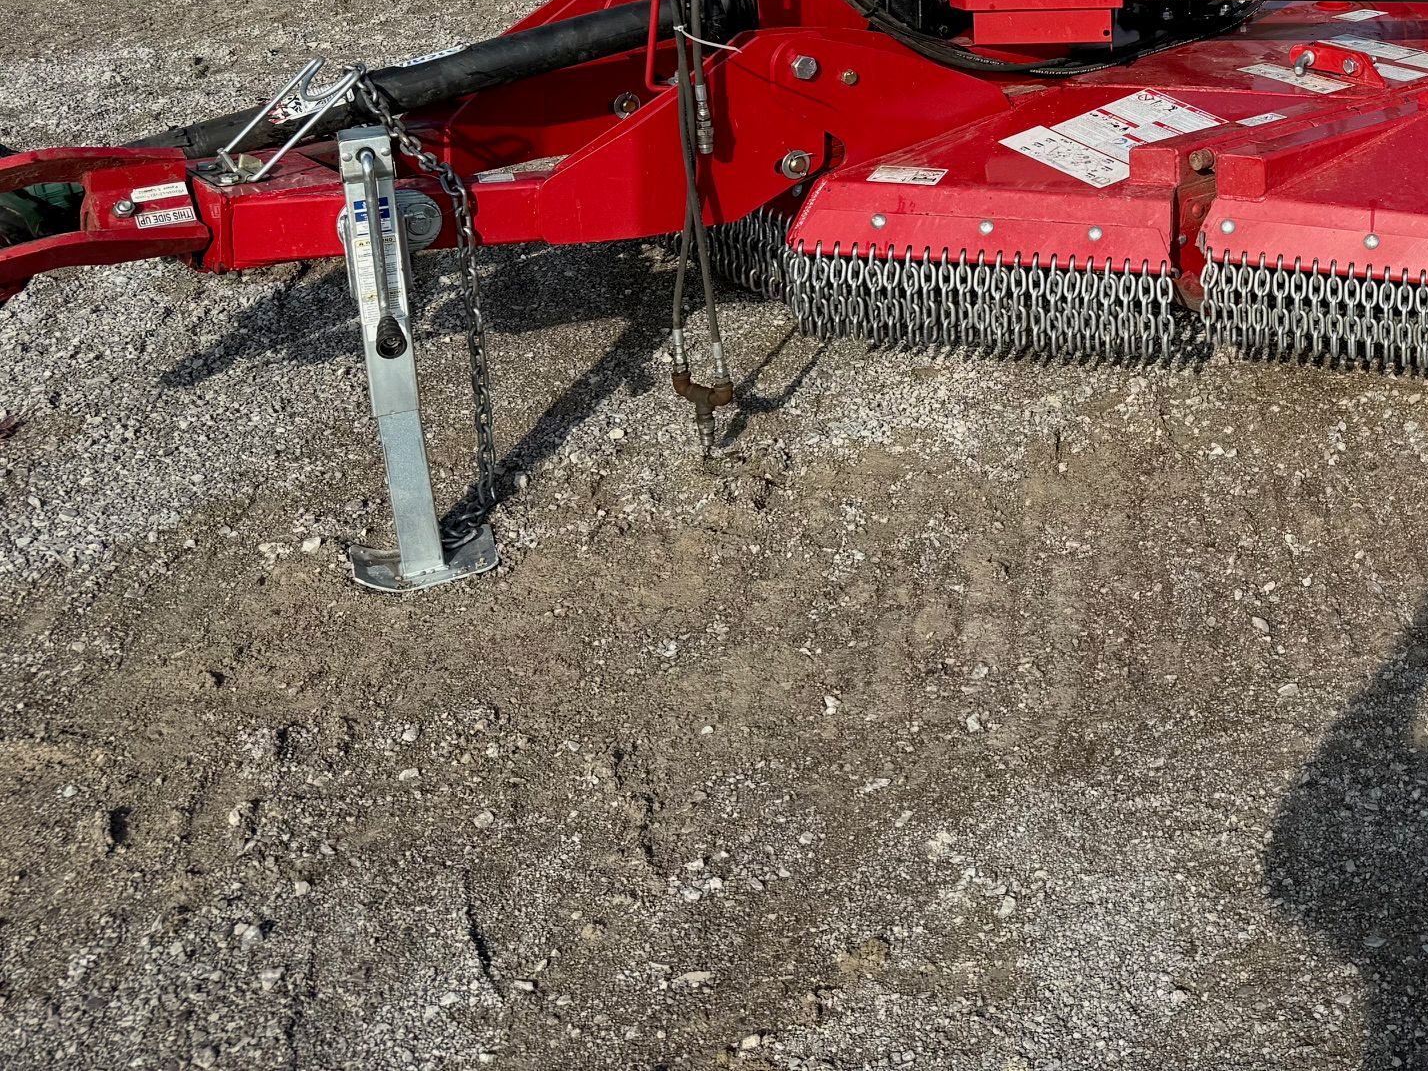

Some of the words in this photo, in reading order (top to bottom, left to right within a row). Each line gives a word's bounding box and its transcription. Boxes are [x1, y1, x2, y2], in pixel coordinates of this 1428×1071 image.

[153, 213, 171, 223] SIDE
[173, 210, 191, 220] THIS
[140, 216, 151, 225] UP
